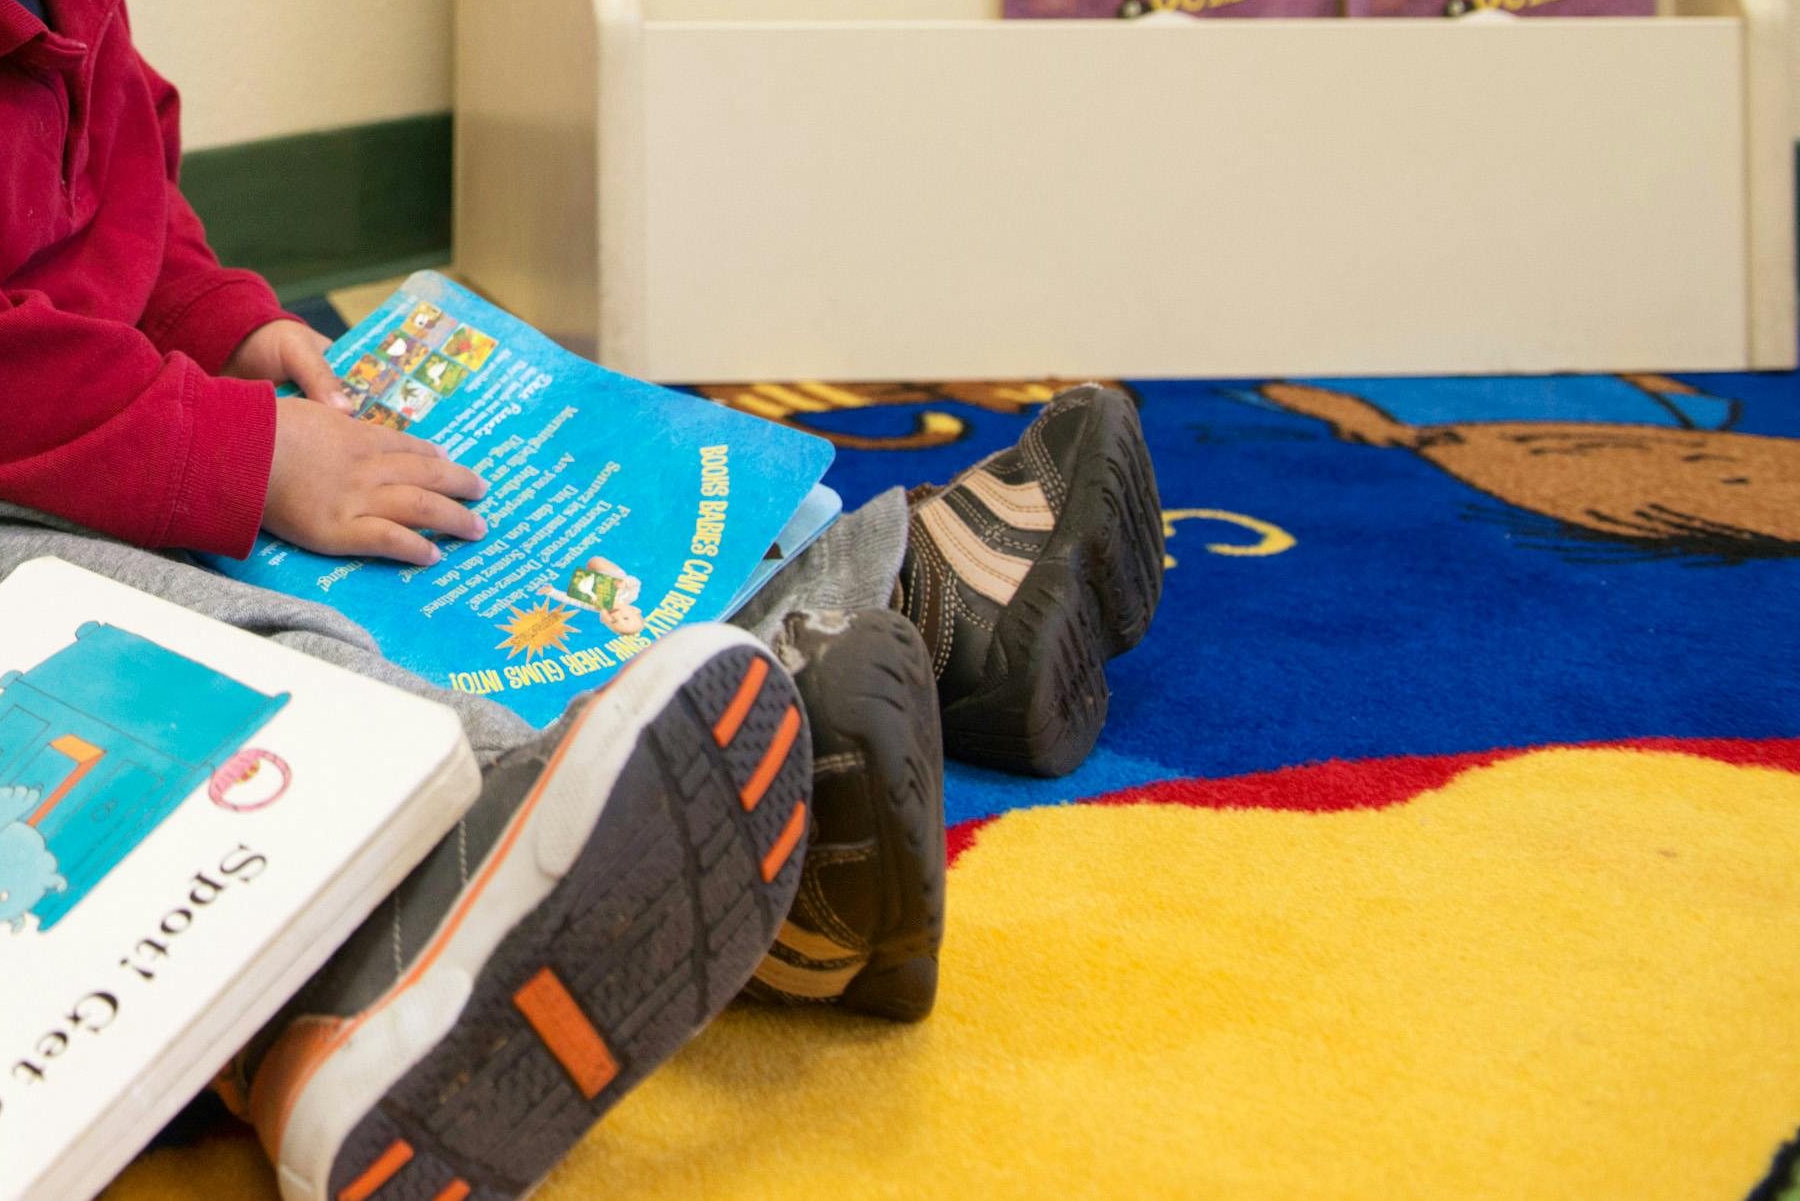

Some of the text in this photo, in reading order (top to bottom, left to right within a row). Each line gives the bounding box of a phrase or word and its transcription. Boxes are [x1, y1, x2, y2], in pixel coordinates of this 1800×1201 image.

[529, 406, 579, 449] Morning
[489, 435, 524, 463] Ding,
[506, 441, 537, 467] bells
[553, 453, 574, 475] Are
[489, 465, 510, 481] are
[495, 465, 540, 499] Brother
[532, 470, 556, 489] you
[483, 488, 536, 528] sleeping?
[420, 462, 620, 618] Sonnez les matines! Sonnez les matines!
[433, 485, 578, 586] Din, dan, don. Din, dan, don.
[551, 533, 601, 568] Jacques,
[448, 444, 730, 696] BOOKS BABIES CAN REALLY SINK THEIR GUMS INTO!
[478, 589, 529, 618] Jacques,
[118, 842, 268, 982] Spot!
[10, 990, 120, 1086] Get
